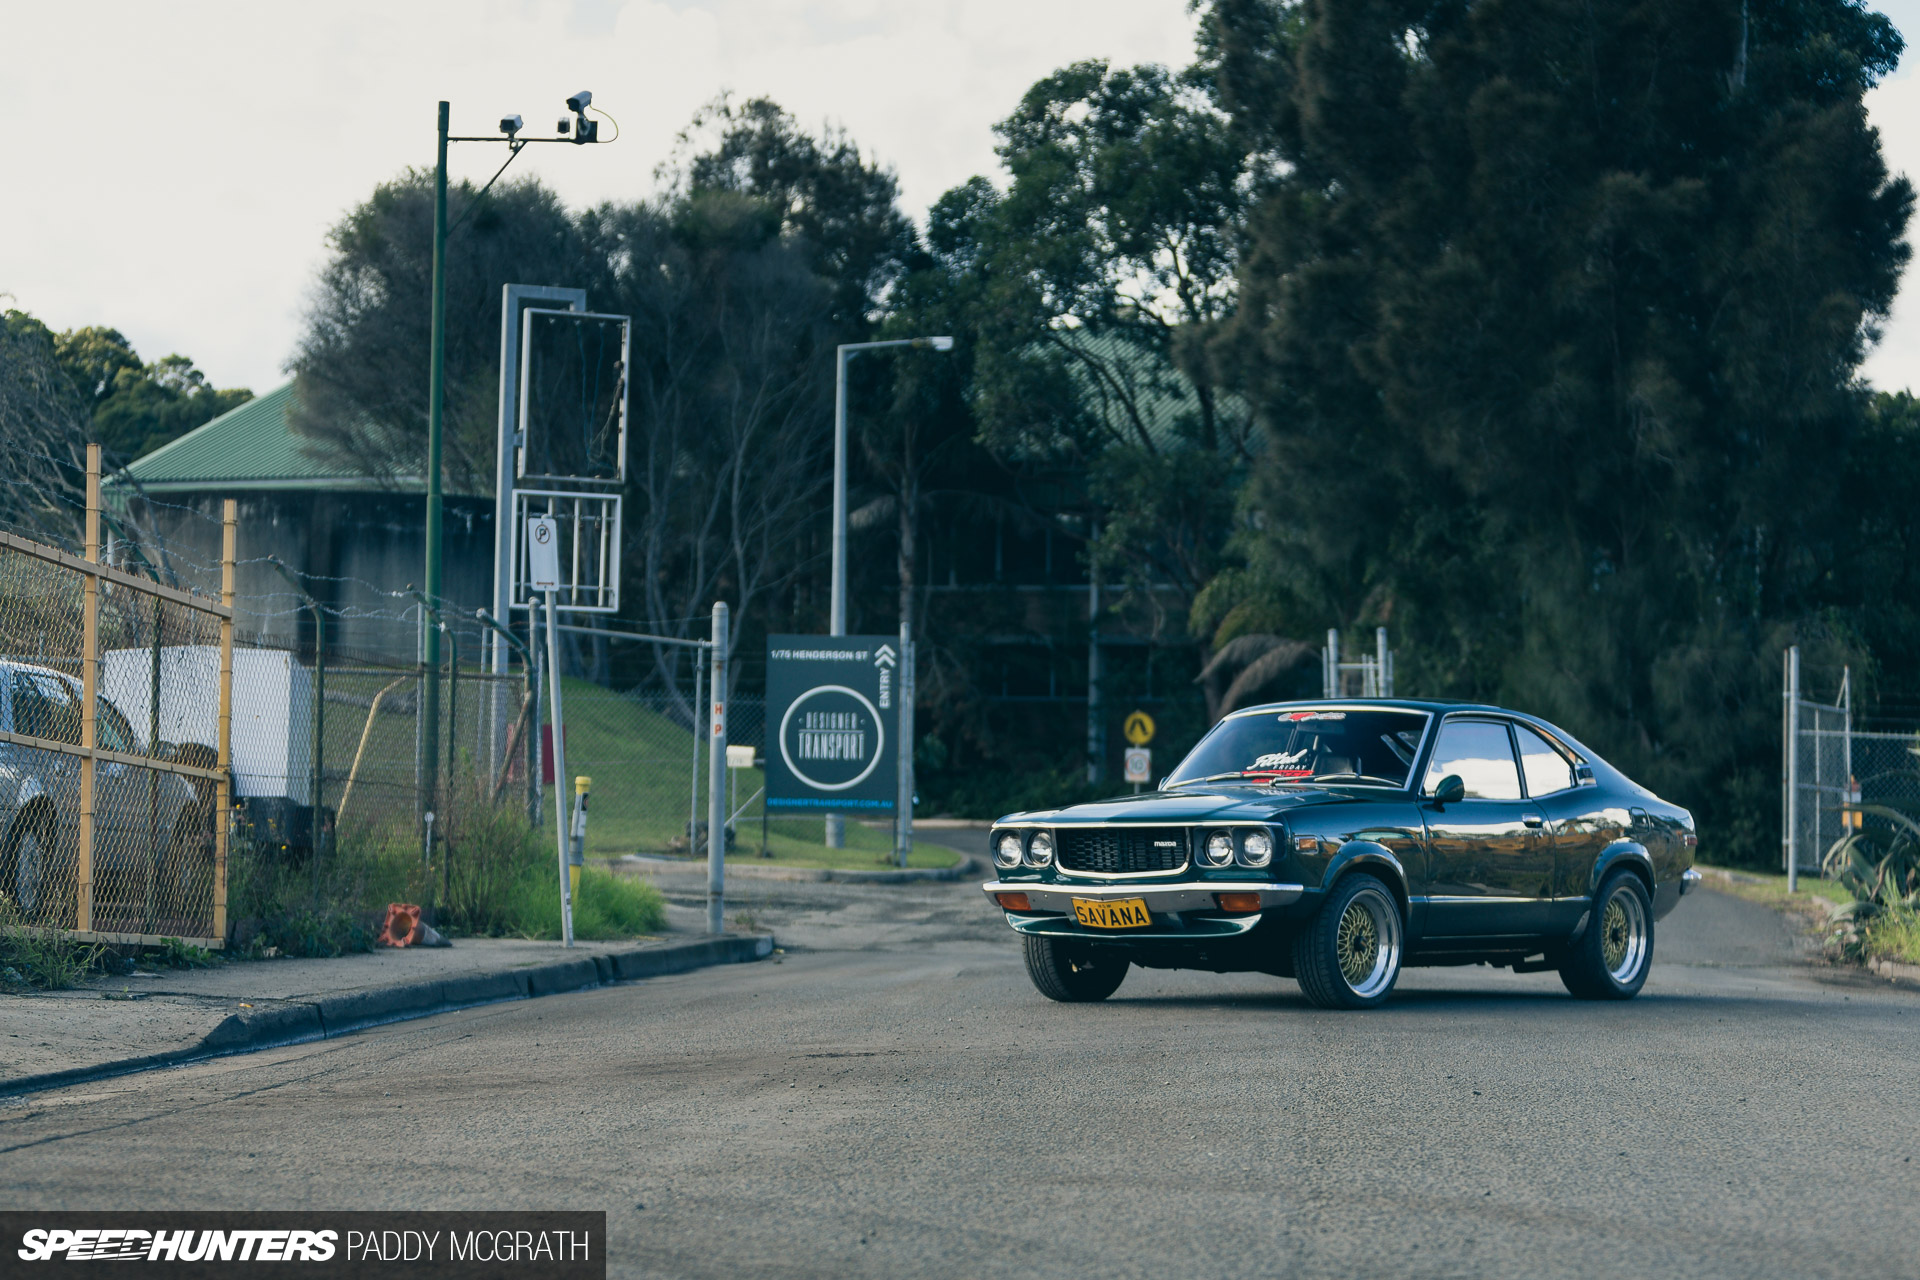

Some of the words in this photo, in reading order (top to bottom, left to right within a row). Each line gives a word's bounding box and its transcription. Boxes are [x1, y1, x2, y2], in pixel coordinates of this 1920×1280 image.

[792, 650, 854, 660] HENDERSON
[855, 651, 868, 660] ST
[879, 667, 891, 709] ENTRY
[806, 712, 858, 730] DESIGNER
[798, 732, 864, 760] TRANSPORT
[1076, 906, 1147, 926] SAVANA
